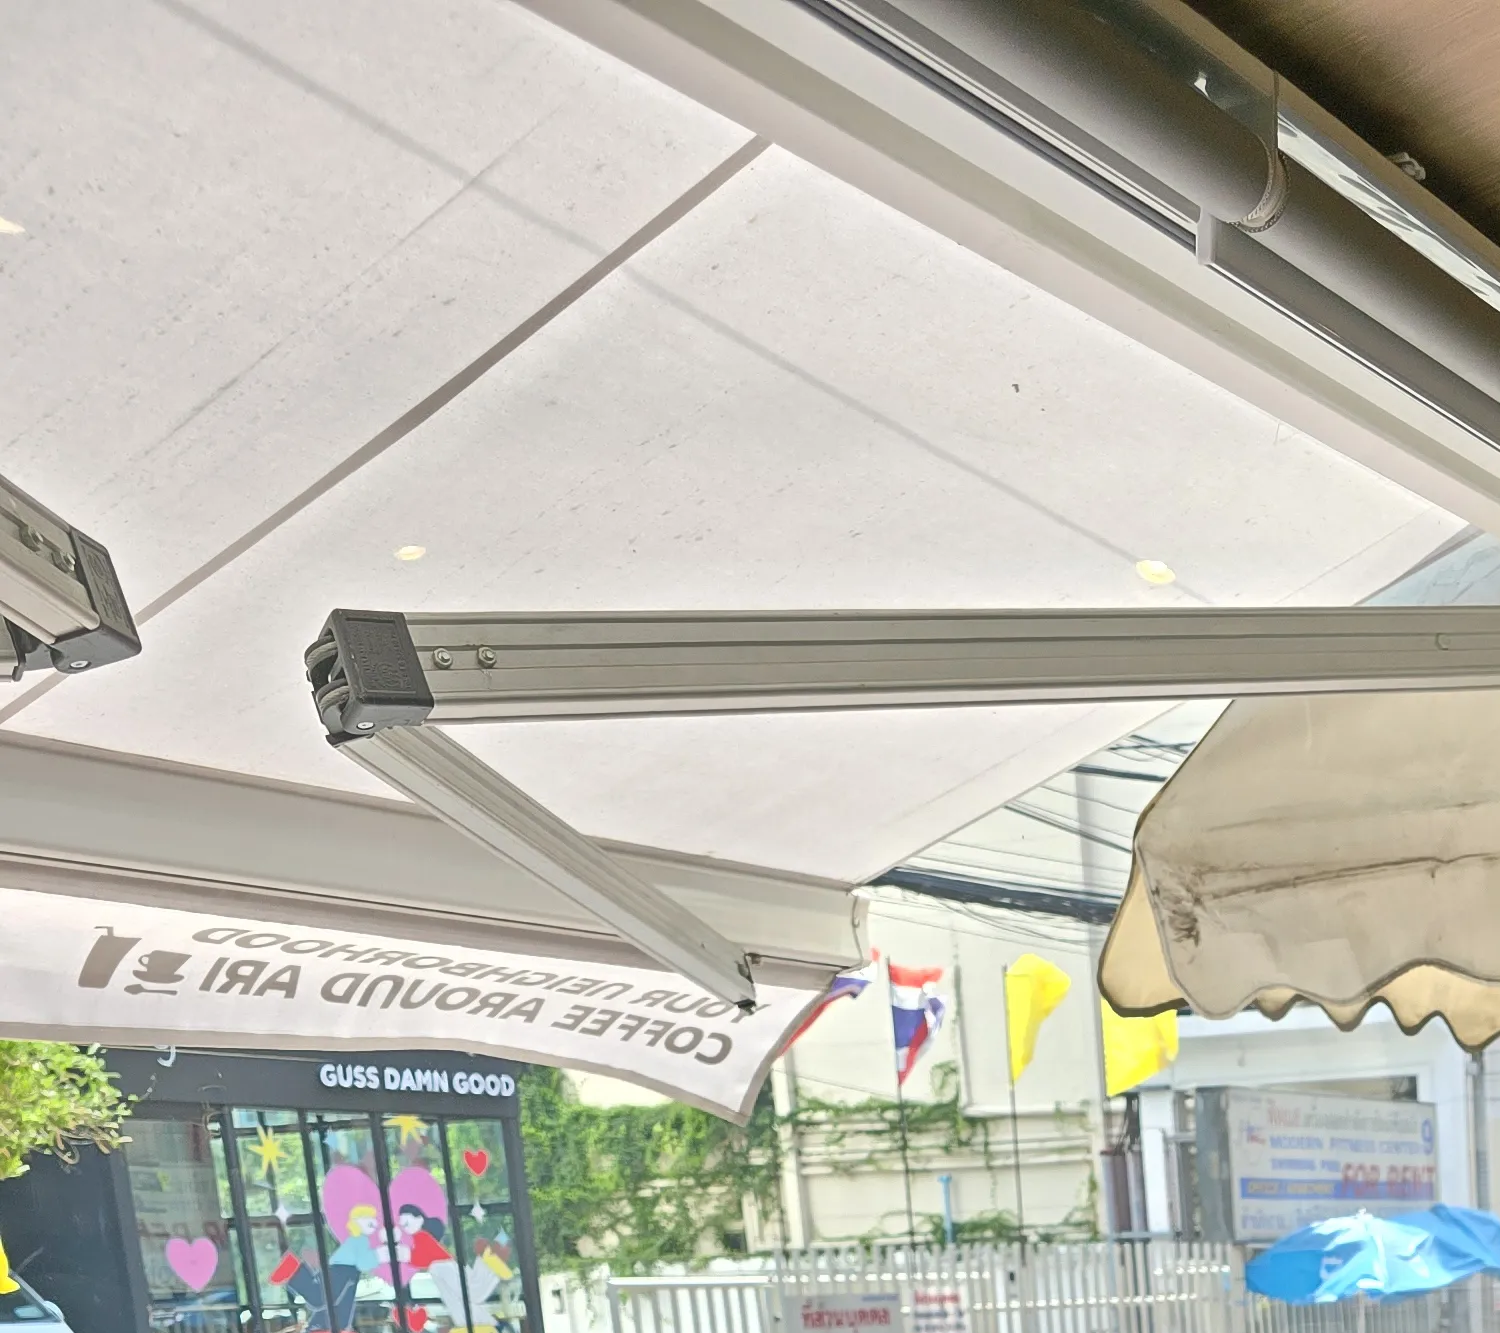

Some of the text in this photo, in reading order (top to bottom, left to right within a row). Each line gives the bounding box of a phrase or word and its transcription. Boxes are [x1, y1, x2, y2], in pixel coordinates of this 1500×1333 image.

[319, 1063, 515, 1097] GUSS DAMN GOOD
